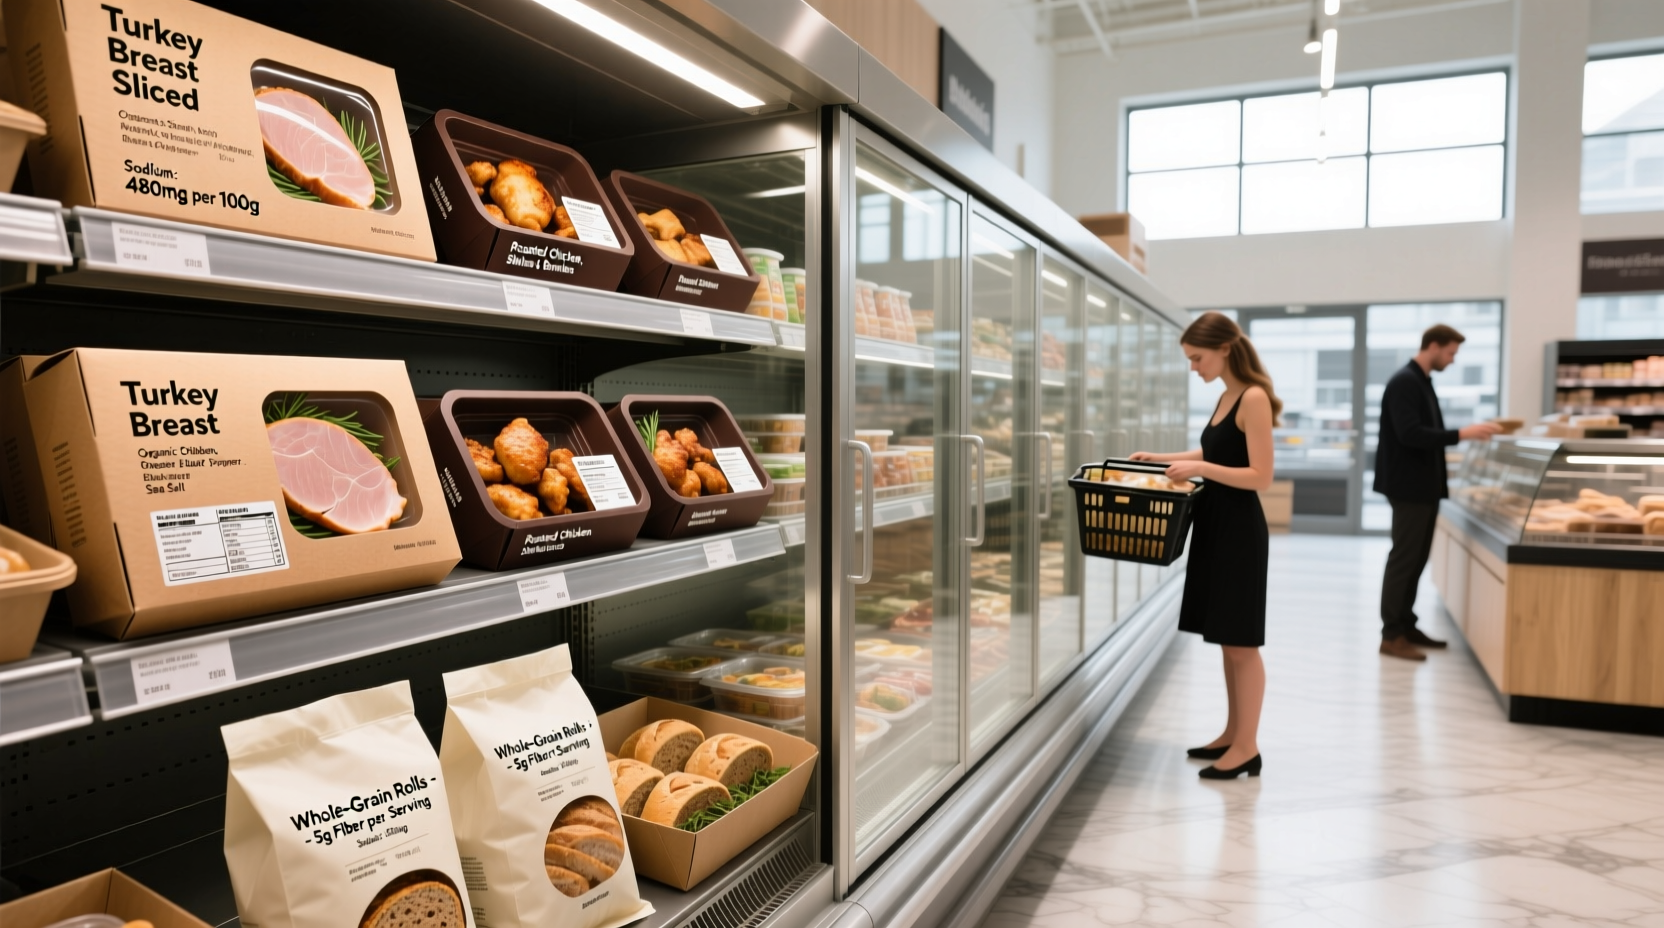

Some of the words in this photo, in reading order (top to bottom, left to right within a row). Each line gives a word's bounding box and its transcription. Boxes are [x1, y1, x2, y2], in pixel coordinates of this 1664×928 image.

[101, 3, 203, 59] Turkey
[107, 36, 200, 83] Breast
[112, 69, 199, 111] Sliced
[125, 176, 188, 206] 480mg
[192, 191, 216, 206] per
[219, 191, 260, 216] 100g
[120, 379, 219, 412] Turkey
[129, 411, 221, 437] Breast
[290, 788, 393, 831] Whole-Grain
[392, 775, 428, 799] Rolls
[313, 829, 333, 845] 5g
[388, 797, 432, 819] Serving
